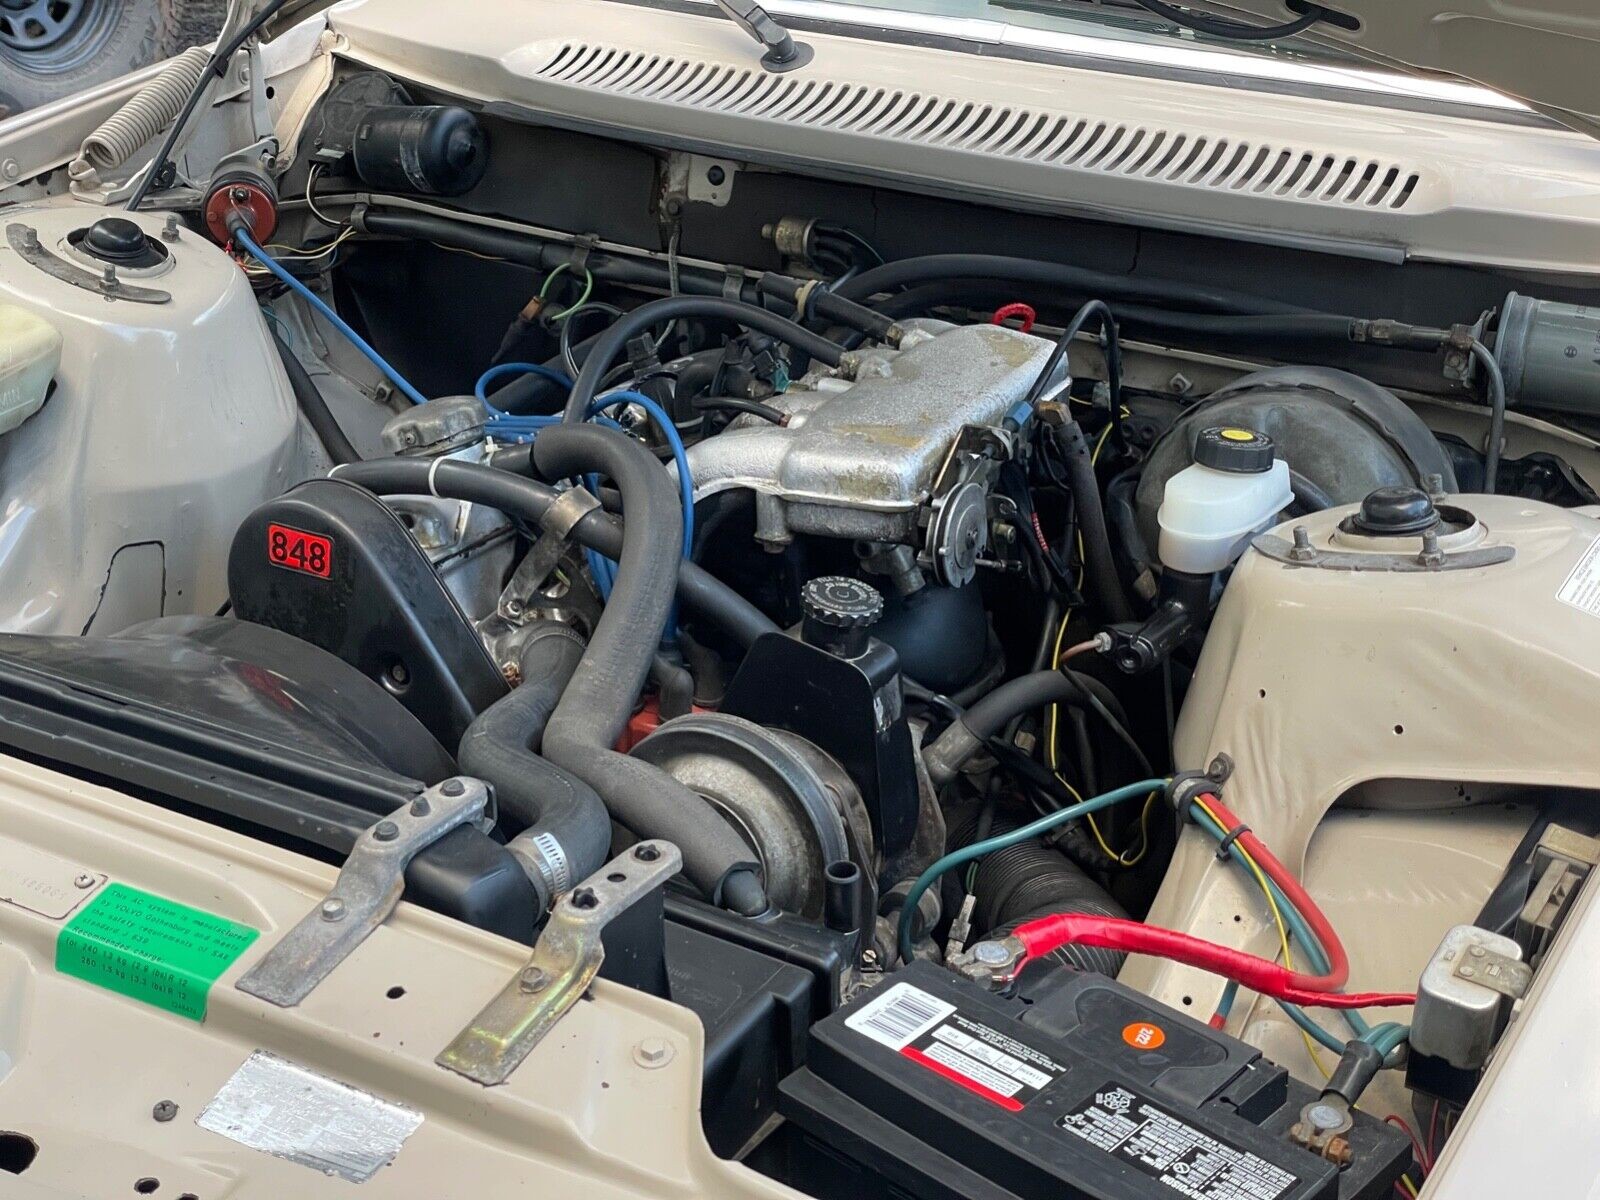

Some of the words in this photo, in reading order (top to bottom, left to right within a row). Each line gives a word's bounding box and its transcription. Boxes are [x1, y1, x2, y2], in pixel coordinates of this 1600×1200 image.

[272, 531, 326, 572] 848
[115, 904, 143, 918] VOLVO
[72, 925, 130, 951] Recommended
